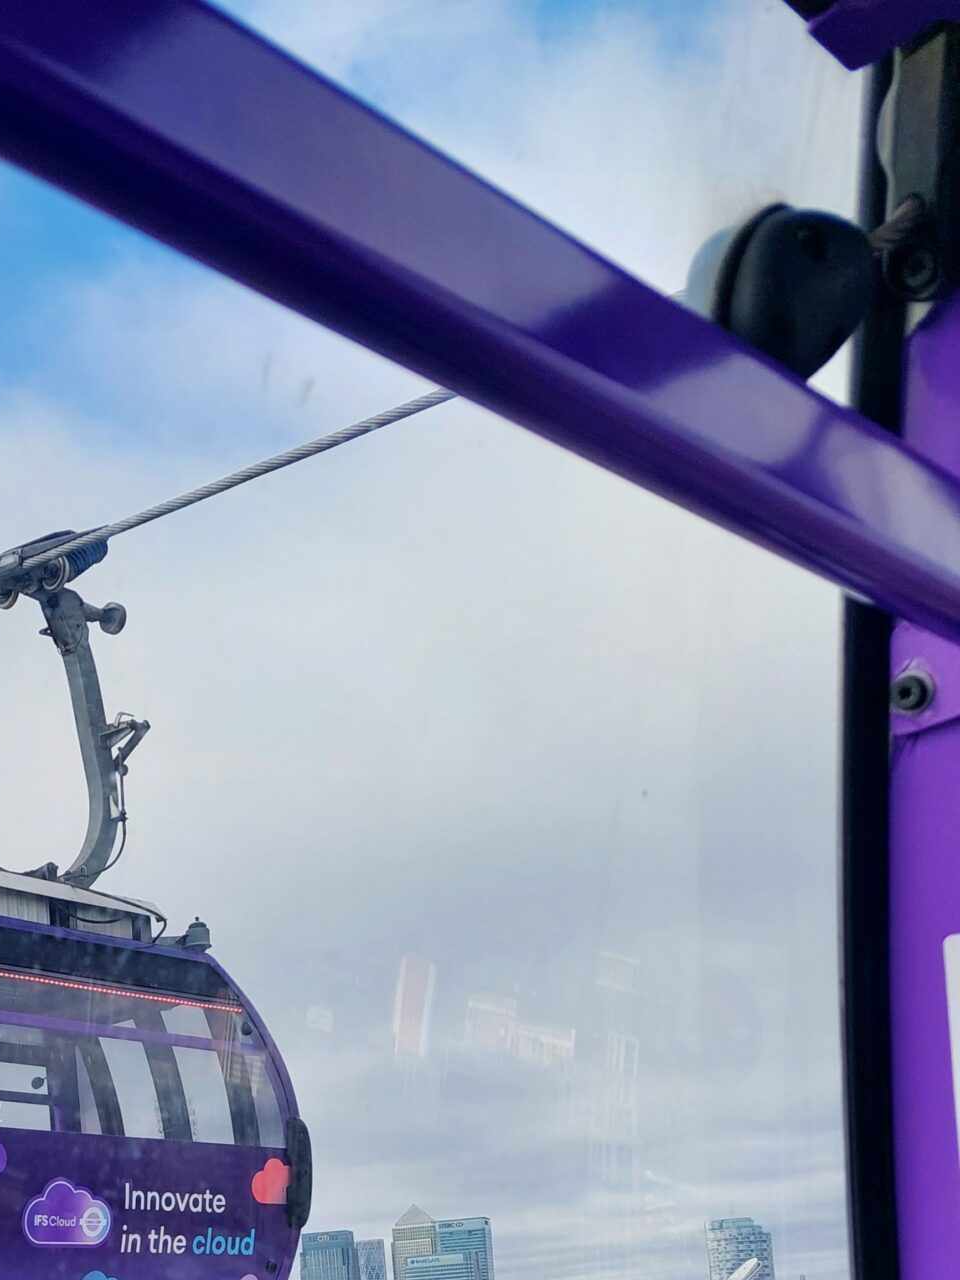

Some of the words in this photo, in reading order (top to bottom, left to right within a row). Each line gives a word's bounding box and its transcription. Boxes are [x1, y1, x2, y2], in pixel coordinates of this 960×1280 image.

[124, 1182, 226, 1213] Innovate
[34, 1214, 48, 1226] IFS
[49, 1215, 76, 1227] Cloud
[120, 1224, 141, 1253] in
[148, 1226, 187, 1254] the
[192, 1227, 256, 1255] cloud
